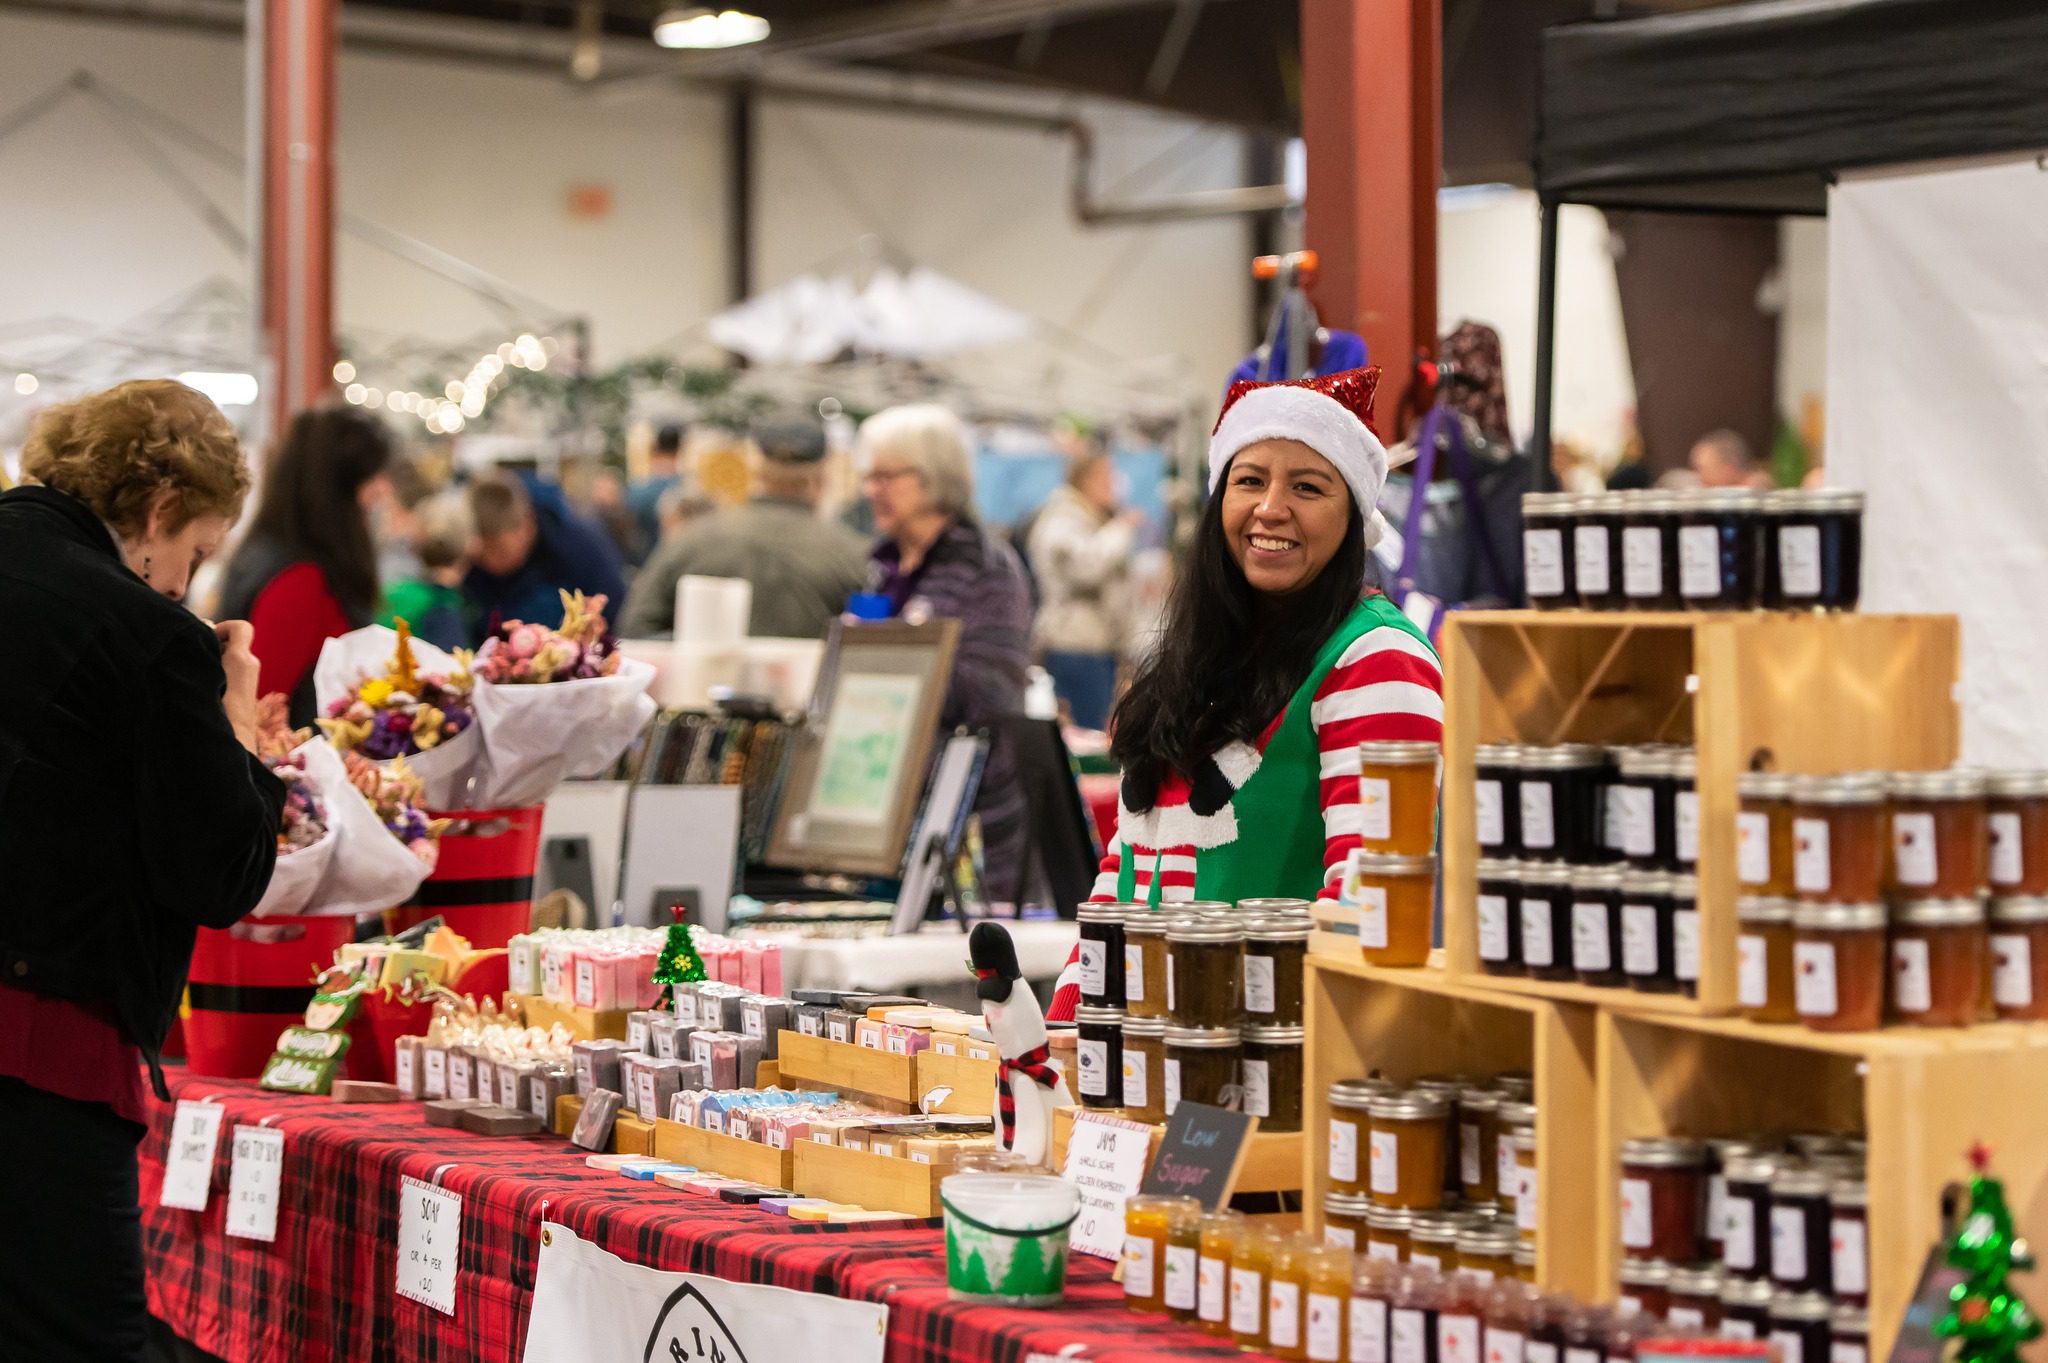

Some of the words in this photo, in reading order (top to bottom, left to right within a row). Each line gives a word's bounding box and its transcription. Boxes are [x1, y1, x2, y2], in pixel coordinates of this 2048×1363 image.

[1181, 1118, 1220, 1148] Low
[1157, 1152, 1211, 1192] Sugar
[410, 1250, 419, 1263] OR
[423, 1252, 428, 1265] 4
[430, 1257, 442, 1272] PER
